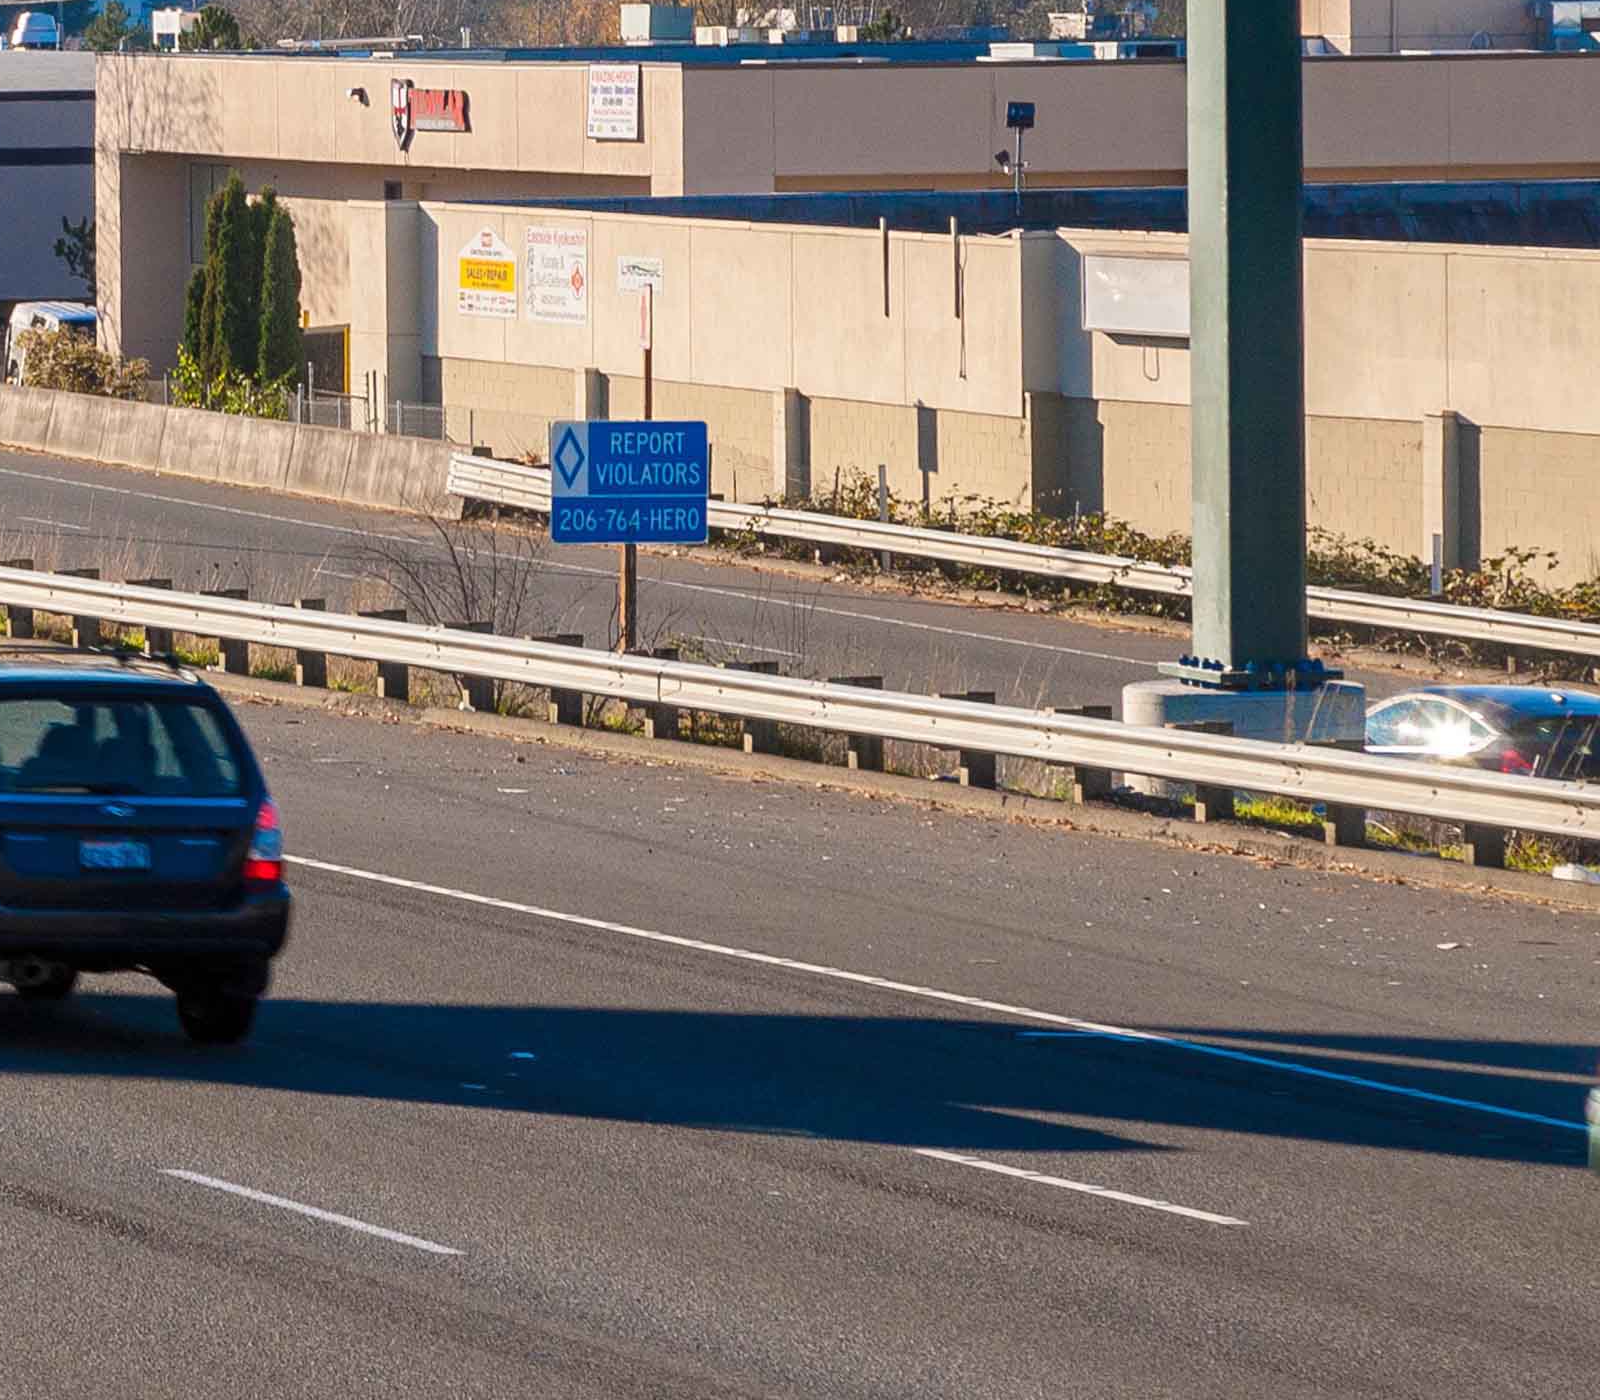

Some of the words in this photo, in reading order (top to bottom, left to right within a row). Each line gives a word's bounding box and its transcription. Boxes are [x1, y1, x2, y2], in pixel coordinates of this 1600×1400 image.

[610, 431, 685, 455] REPORT
[595, 462, 701, 486] VIOLATORS
[559, 507, 700, 532] 206-764-HERO
